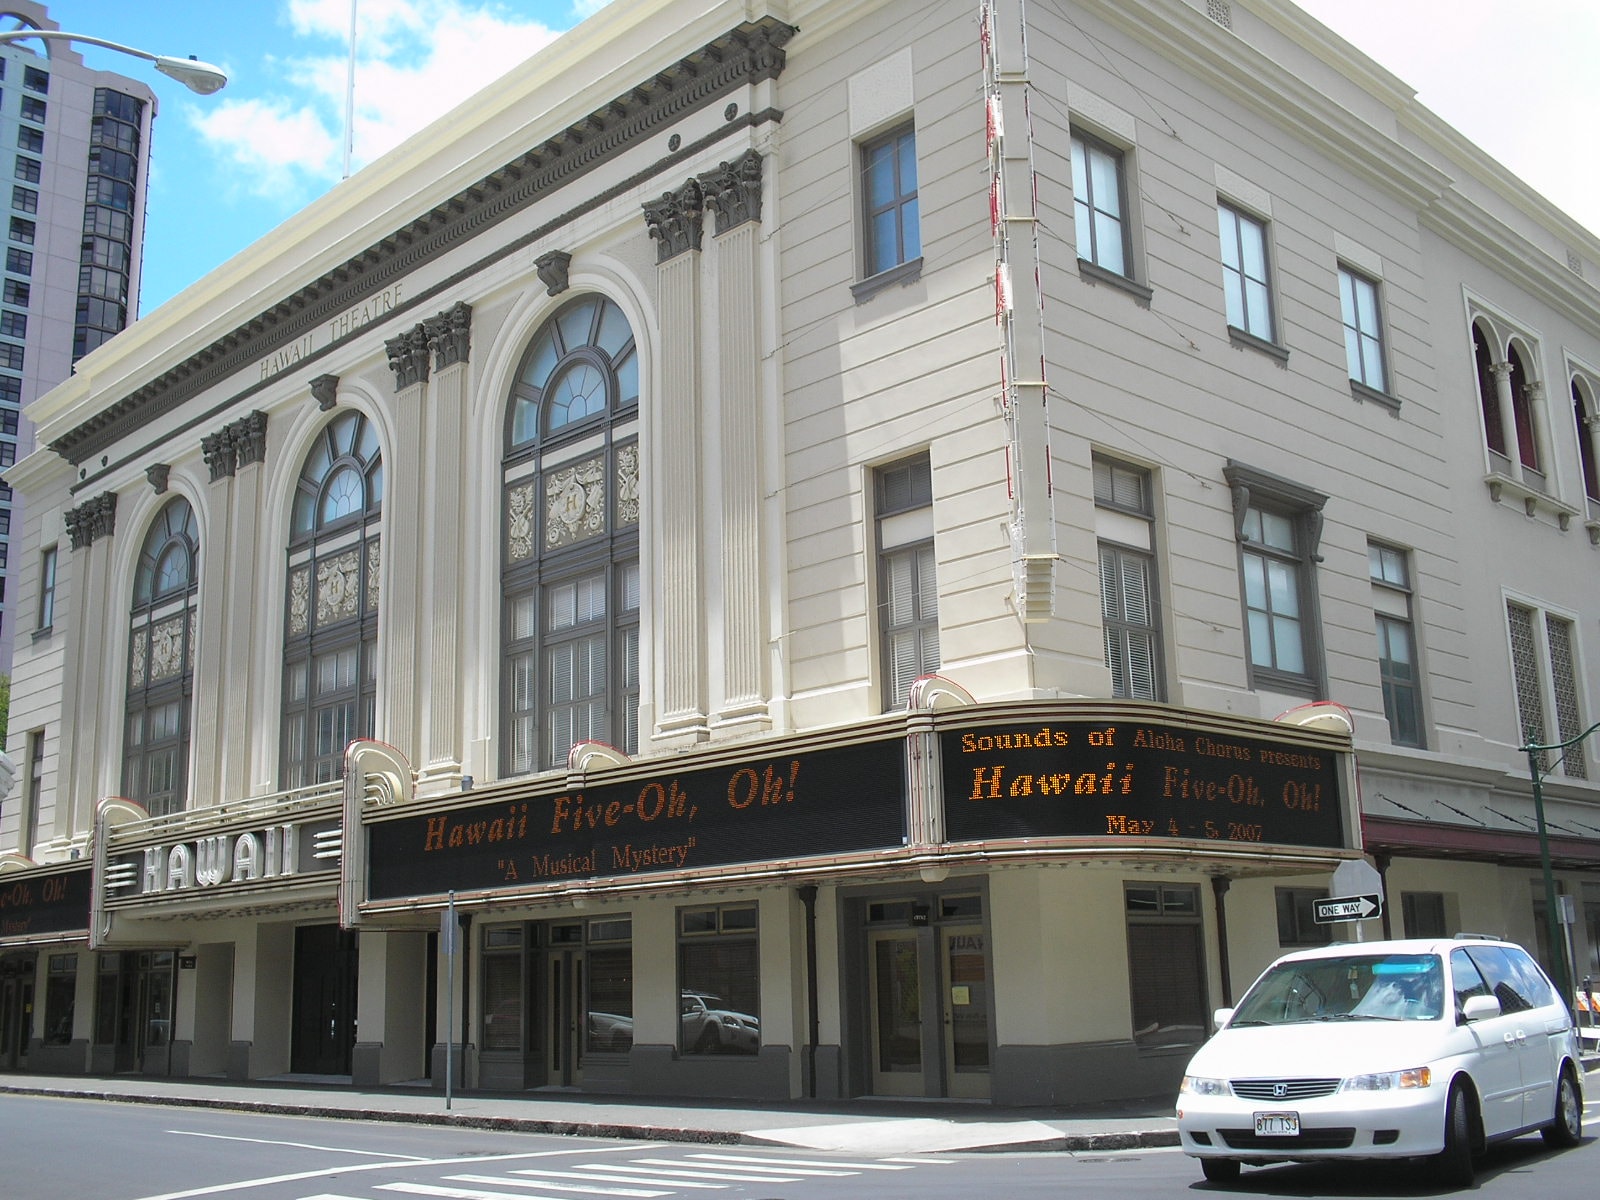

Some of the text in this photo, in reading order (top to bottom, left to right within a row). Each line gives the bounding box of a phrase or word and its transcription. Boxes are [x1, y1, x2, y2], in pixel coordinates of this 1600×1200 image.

[260, 283, 403, 381] HAWAII THEATRE
[962, 728, 1068, 752] Sounds
[1088, 727, 1115, 746] of
[1133, 729, 1185, 752] Aloha
[1195, 737, 1251, 761] Chorus
[424, 760, 799, 851] Hawaii Five-Oh, Oh!
[968, 762, 1321, 811] Hawaii Five-Oh, Oh!
[1106, 815, 1154, 835] May
[1167, 817, 1180, 837] 4
[1227, 822, 1263, 841] 2007
[142, 824, 299, 894] HAWAII
[498, 836, 697, 881] "A Musical Mystery"
[1321, 903, 1361, 916] ONE WAY
[1256, 1117, 1297, 1131] 877 TSJ
